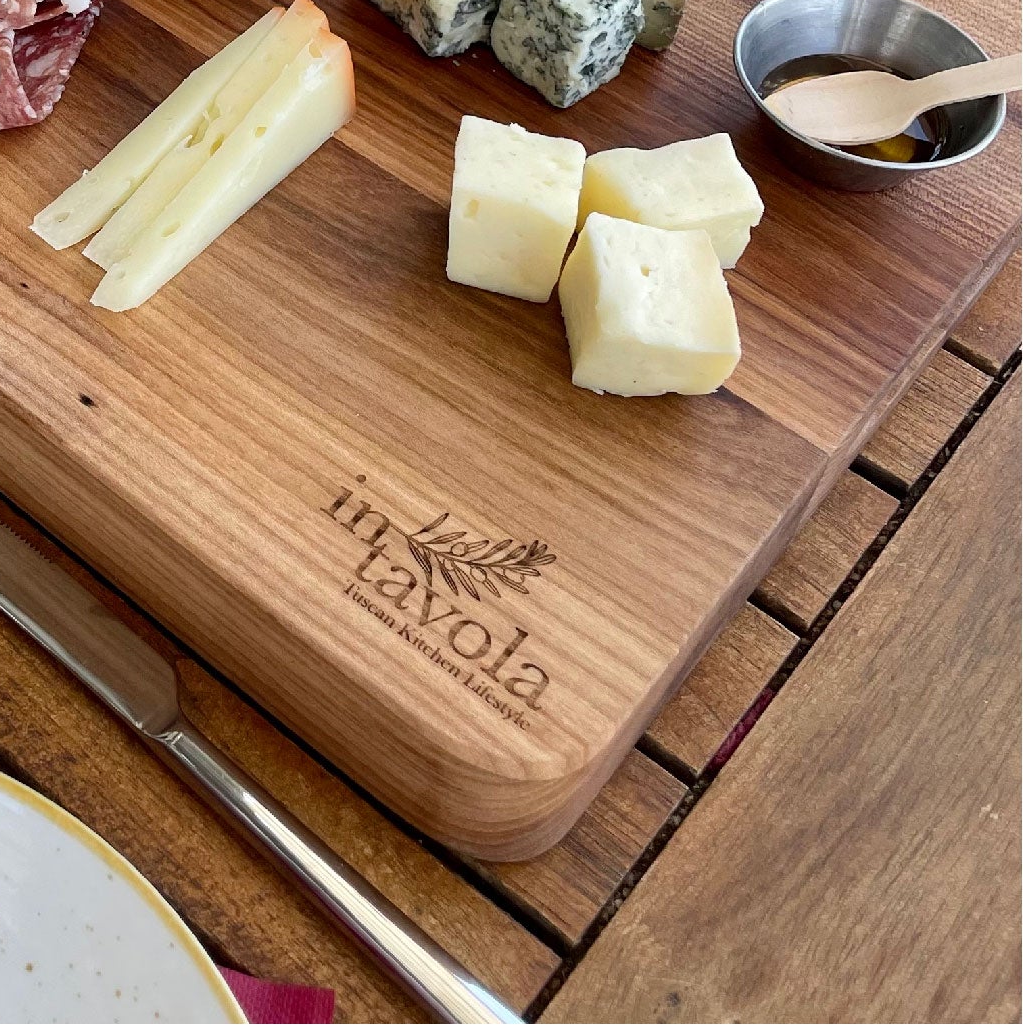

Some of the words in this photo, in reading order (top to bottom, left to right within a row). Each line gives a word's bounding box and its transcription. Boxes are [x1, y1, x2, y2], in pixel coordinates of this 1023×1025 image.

[320, 474, 391, 547] in
[343, 580, 396, 629] Tuscan
[397, 622, 462, 679] Kitchen
[463, 672, 532, 732] Lifestyle
[355, 543, 550, 712] tavola
